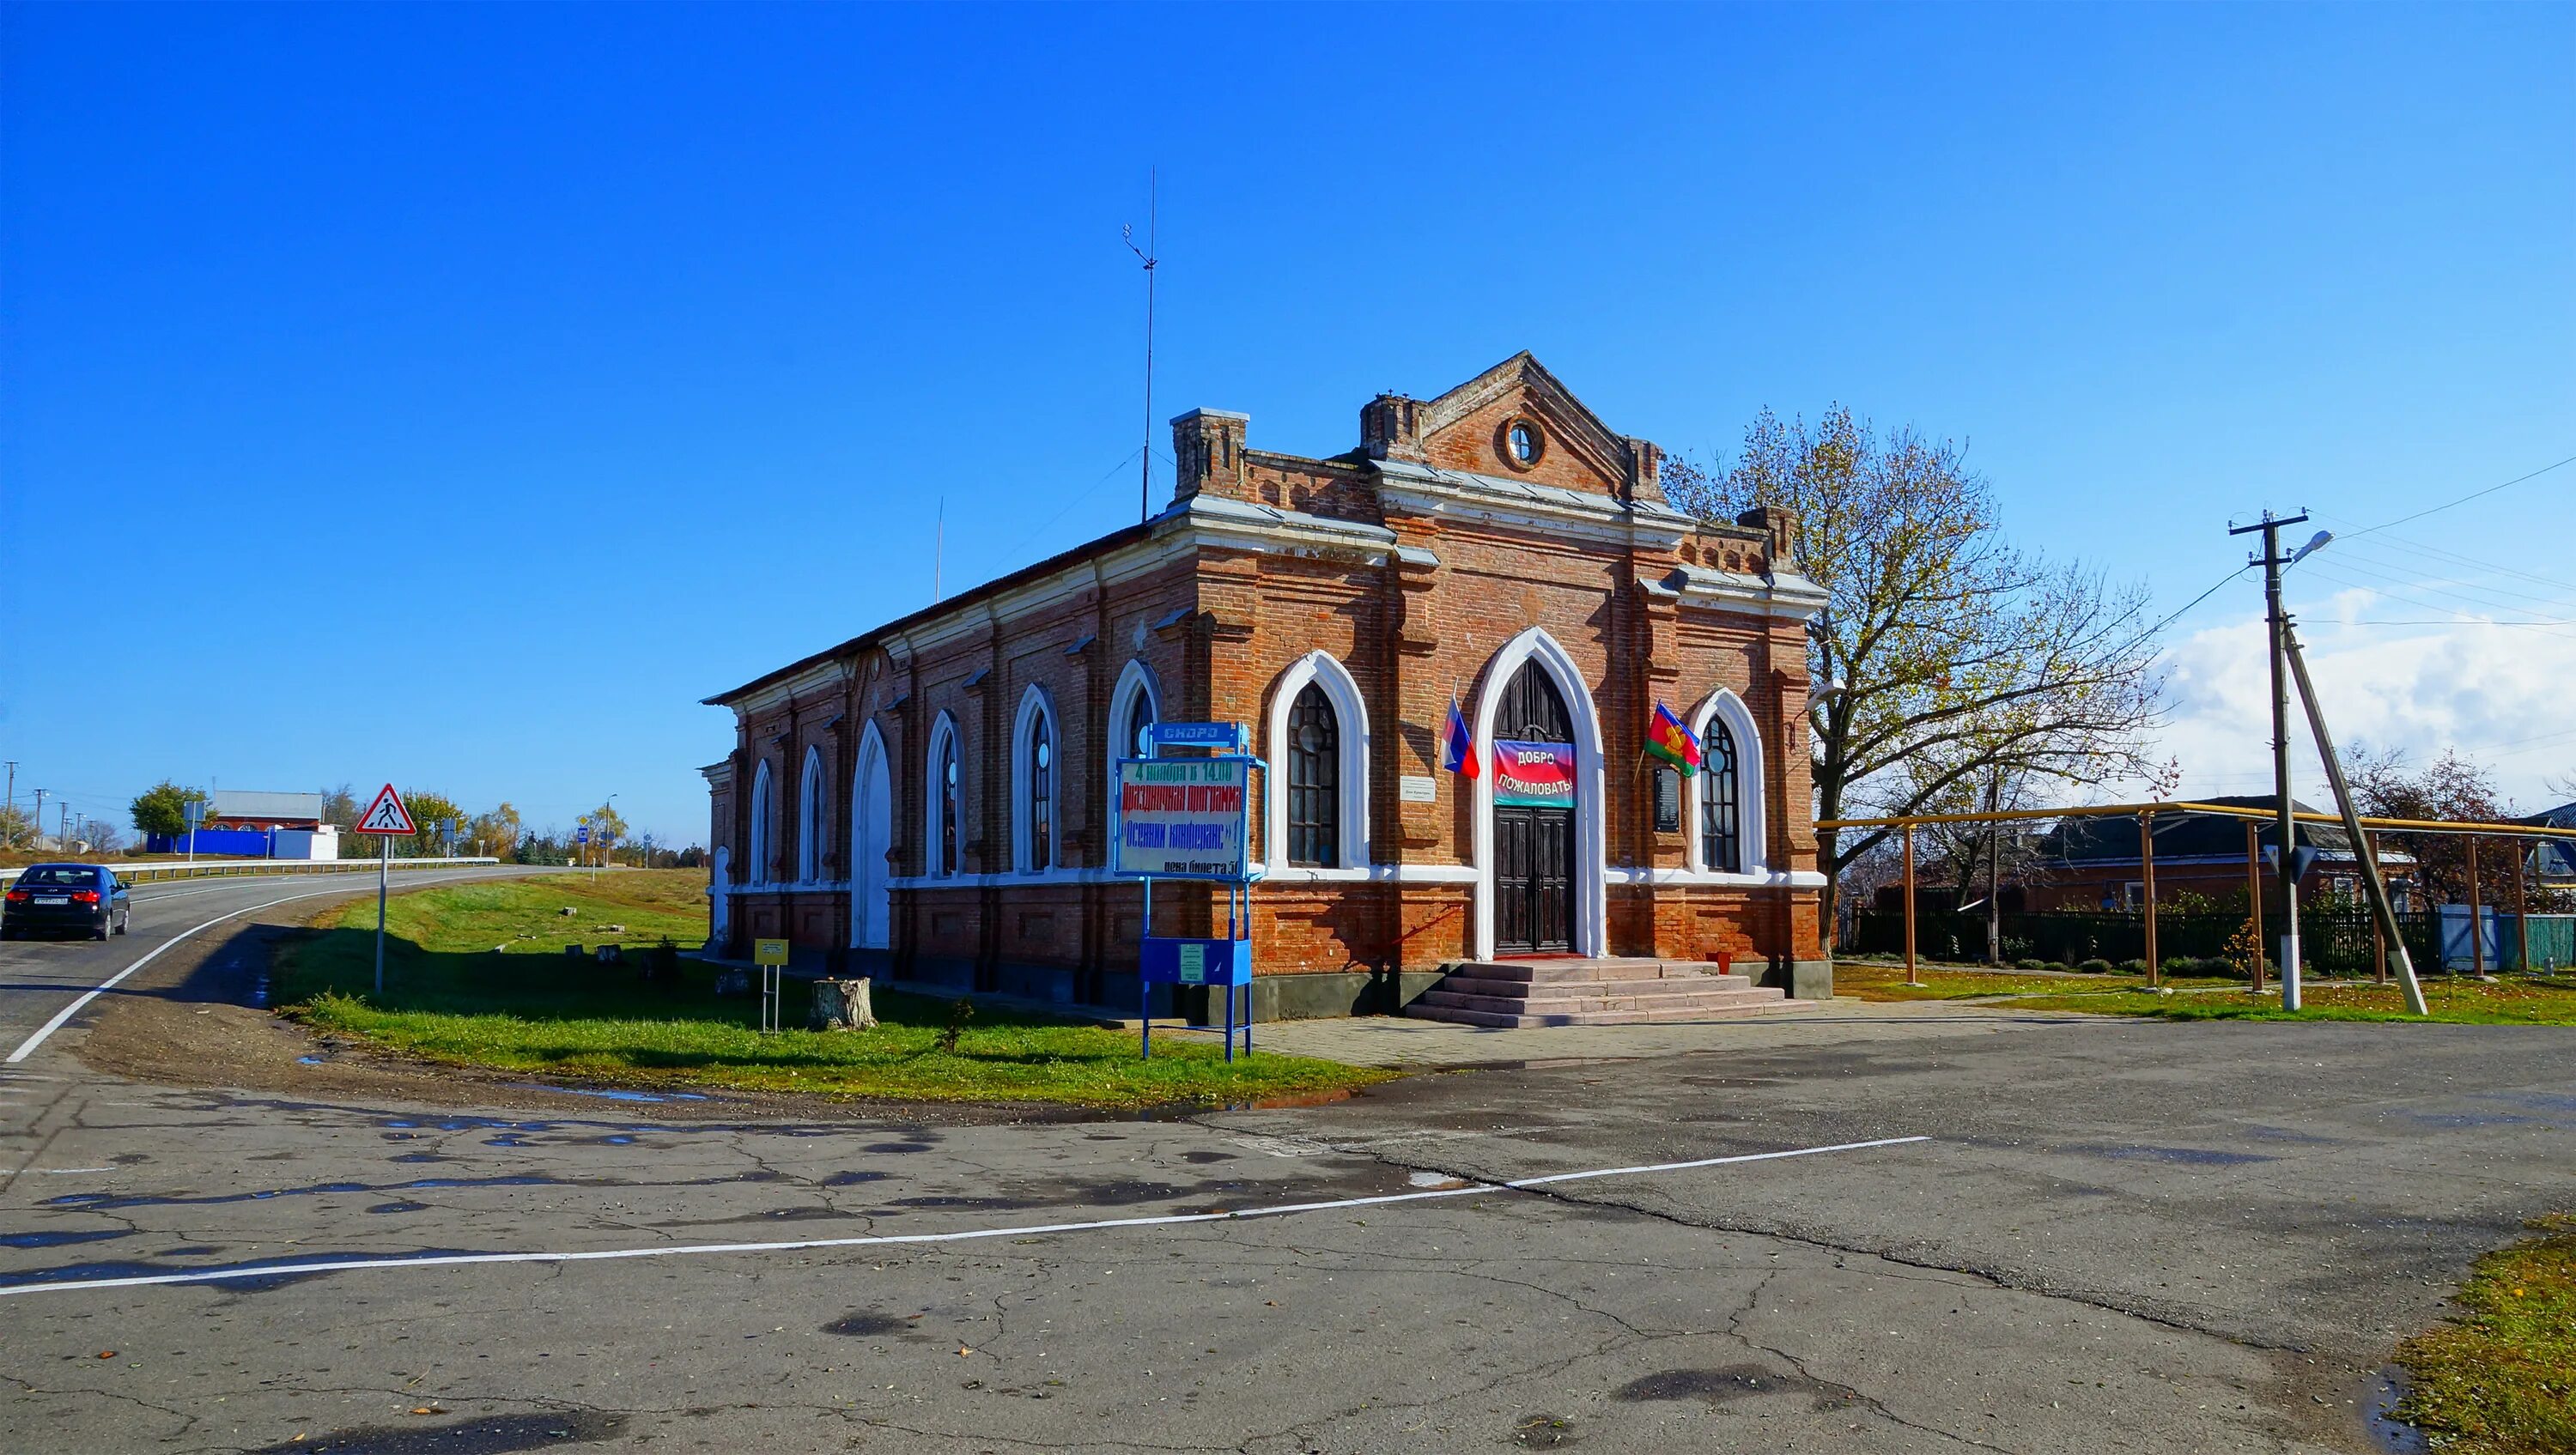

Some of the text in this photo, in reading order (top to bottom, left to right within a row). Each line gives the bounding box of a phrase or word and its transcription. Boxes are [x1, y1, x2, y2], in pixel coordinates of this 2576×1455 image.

[1164, 727, 1218, 739] СКОРО
[1517, 751, 1555, 767] ДОБРО
[1135, 762, 1232, 783] 4 ноября в 14.00
[1498, 773, 1573, 795] ПОЖАЛОВАТЬ!
[1122, 782, 1242, 814] Праздничная программа
[1164, 861, 1187, 873] цена
[1188, 859, 1226, 874] билета
